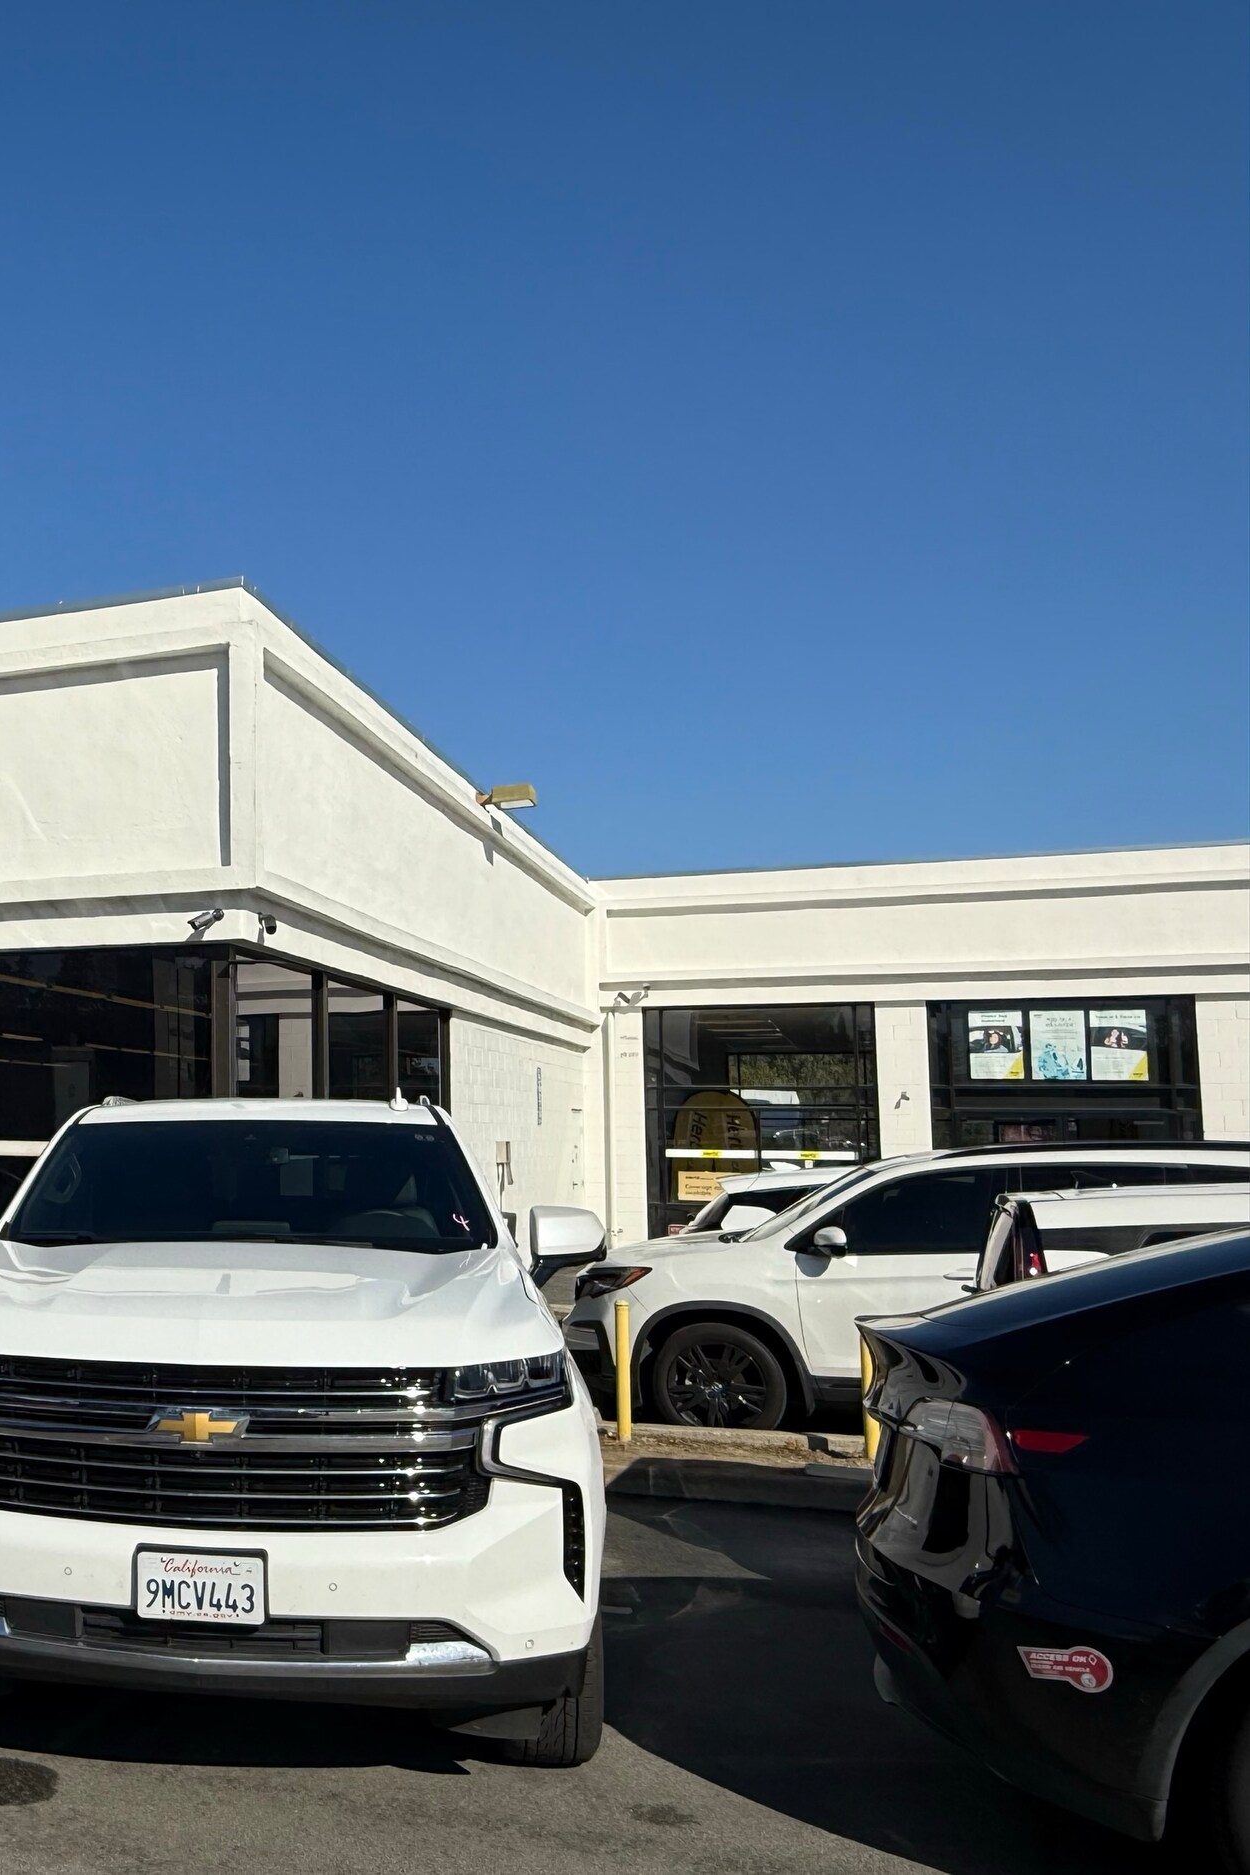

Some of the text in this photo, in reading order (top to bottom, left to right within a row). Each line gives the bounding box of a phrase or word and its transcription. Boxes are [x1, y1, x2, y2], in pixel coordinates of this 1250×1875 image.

[690, 1111, 708, 1149] Her
[163, 1557, 241, 1579] California
[145, 1578, 255, 1614] 9MCV443
[1072, 1655, 1088, 1663] OK
